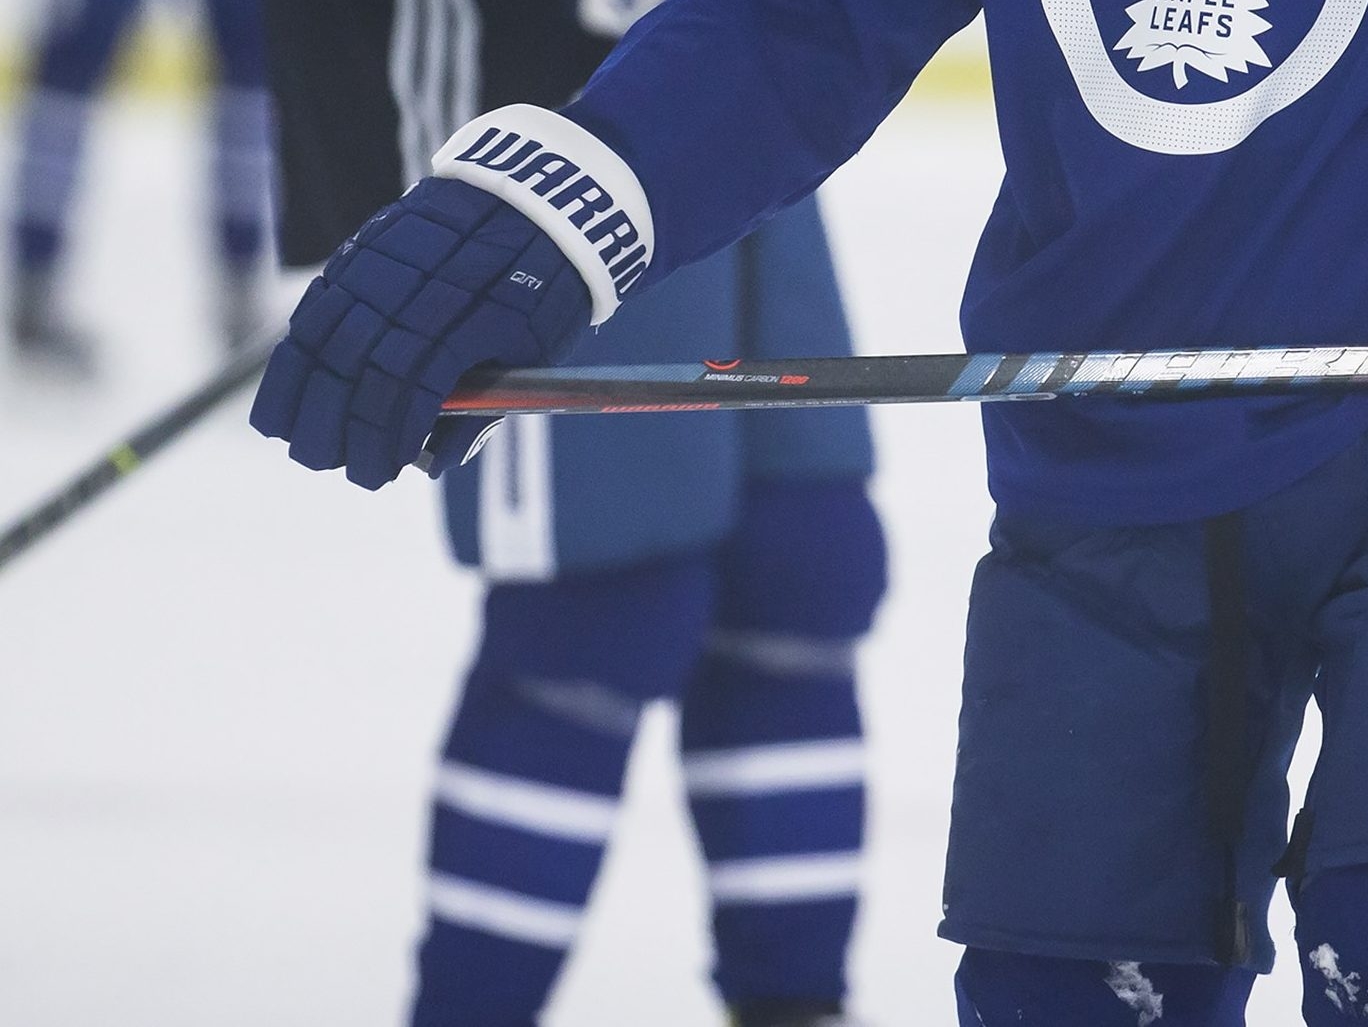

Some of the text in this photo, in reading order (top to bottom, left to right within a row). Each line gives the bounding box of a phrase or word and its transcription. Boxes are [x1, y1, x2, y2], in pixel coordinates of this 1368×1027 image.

[1149, 5, 1234, 39] LEAFS
[704, 373, 744, 383] MINIMUS
[744, 374, 780, 384] CARBON
